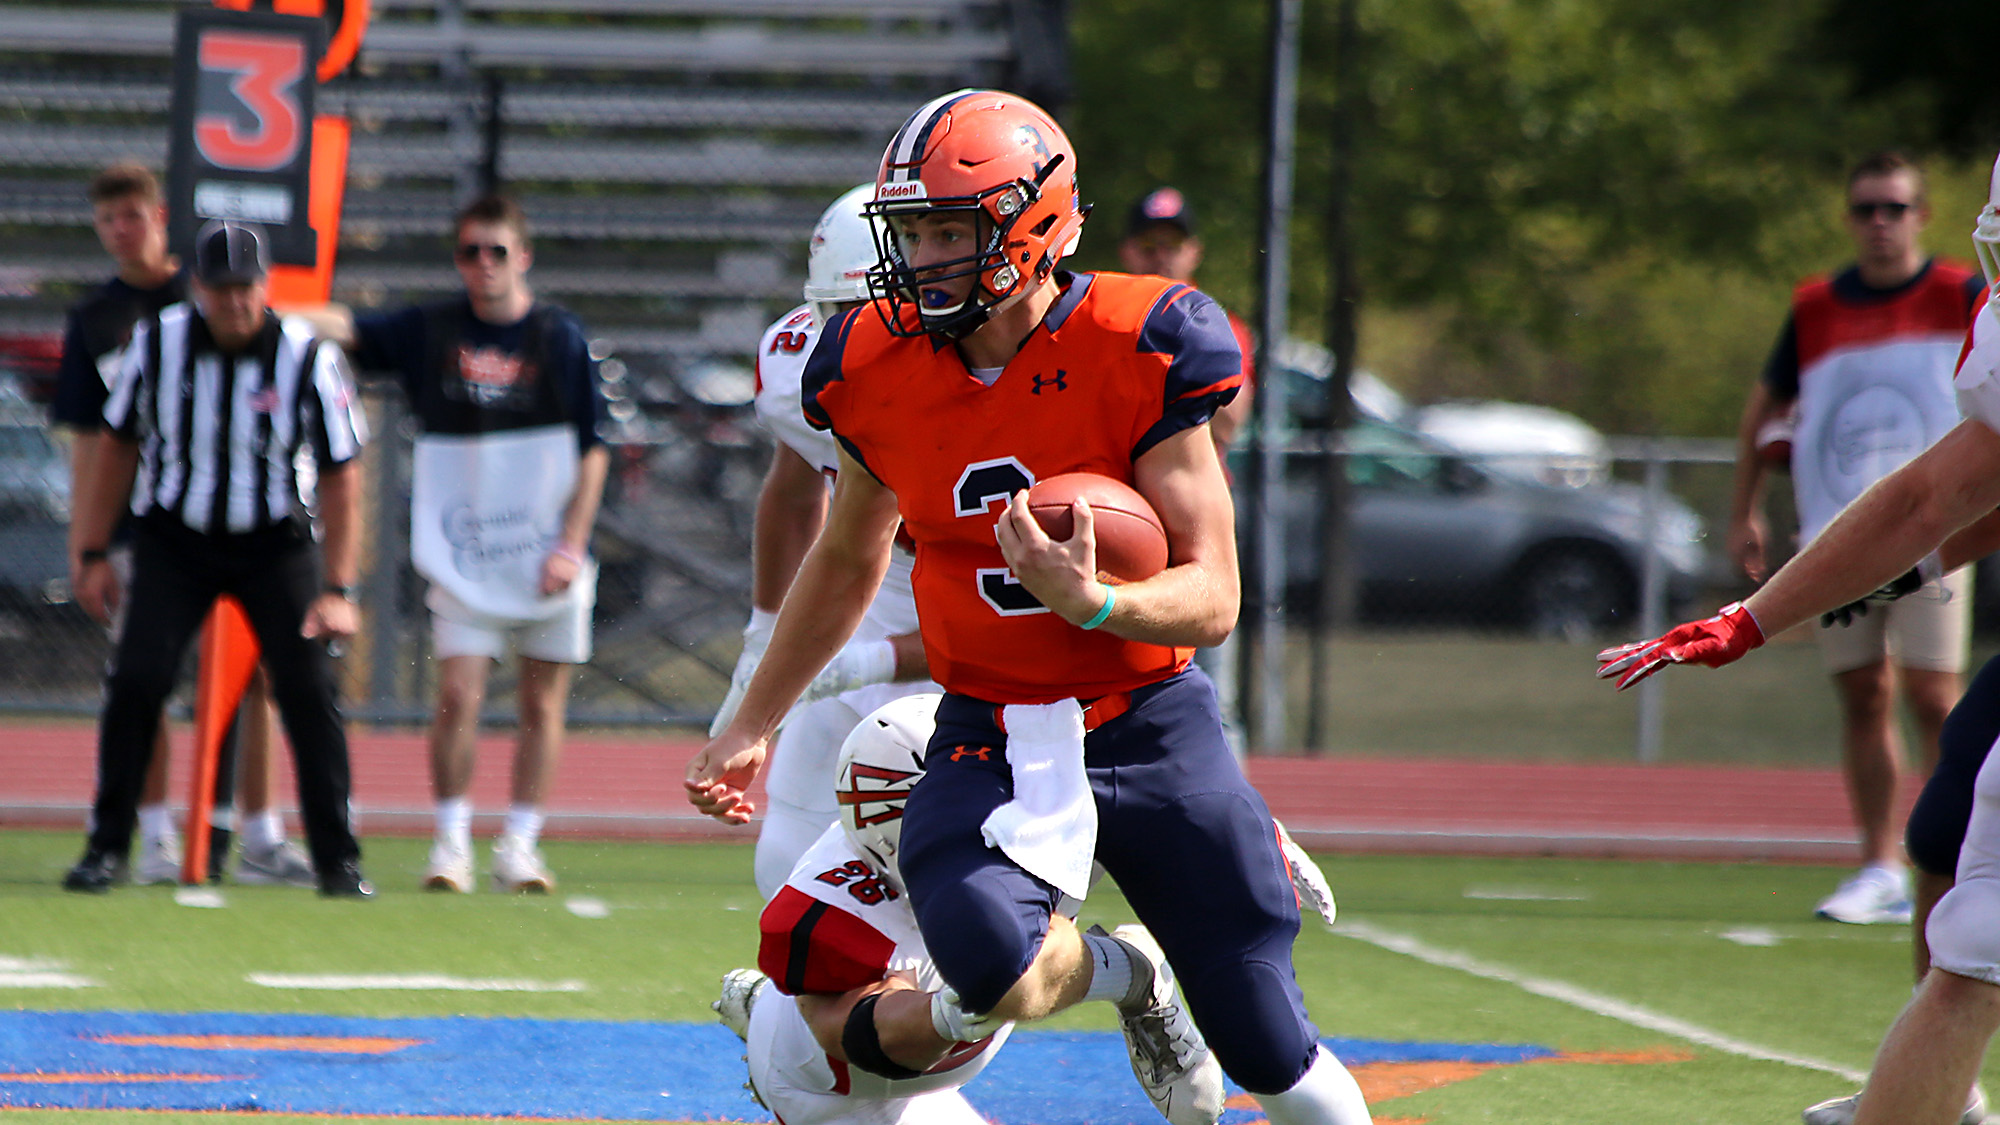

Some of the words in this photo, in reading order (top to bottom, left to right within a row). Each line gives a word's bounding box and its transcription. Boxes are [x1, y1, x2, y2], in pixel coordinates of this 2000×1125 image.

[196, 32, 303, 171] 3
[1016, 124, 1052, 182] 3
[881, 184, 917, 198] Riddell
[953, 456, 1052, 617] 3
[814, 859, 899, 906] 26
